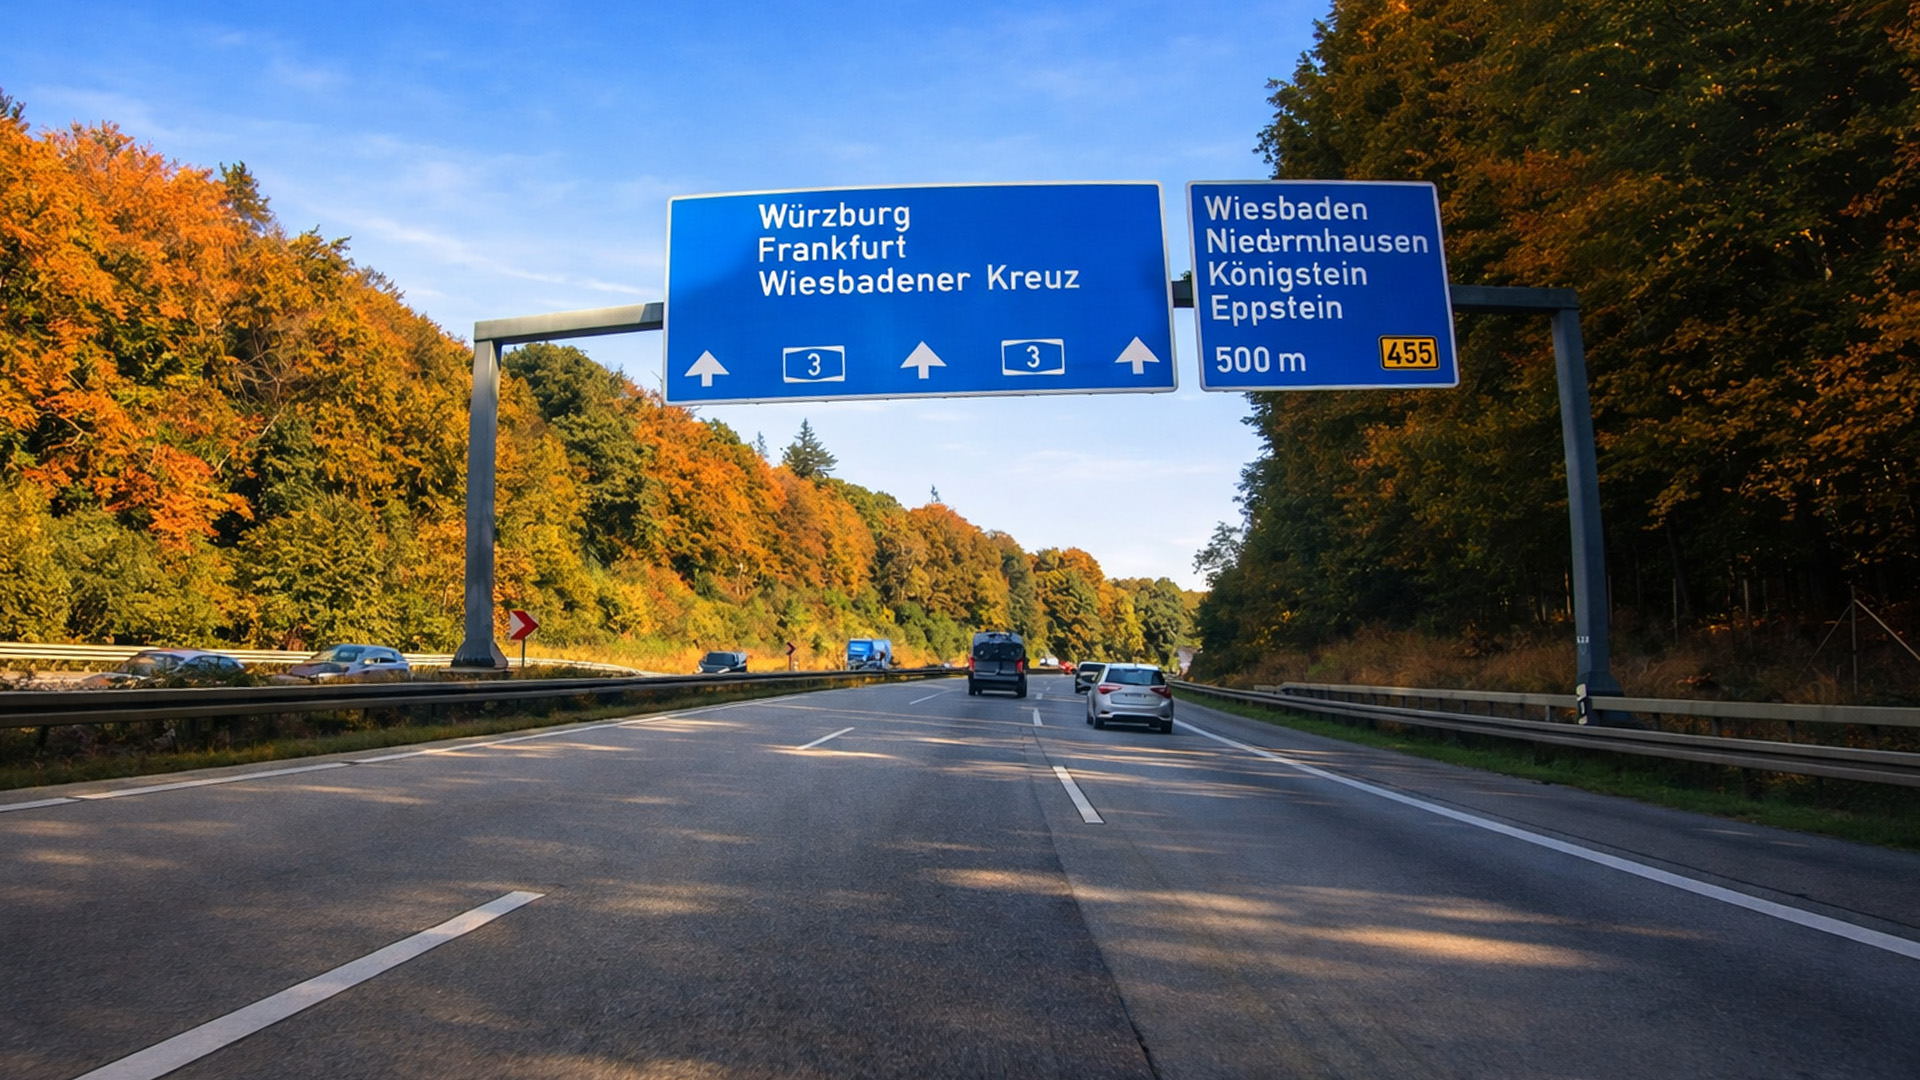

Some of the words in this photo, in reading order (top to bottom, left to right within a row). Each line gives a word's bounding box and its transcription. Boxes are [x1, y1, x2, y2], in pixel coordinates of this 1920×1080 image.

[758, 203, 911, 232] Würzburg
[1204, 195, 1368, 221] Wiesbaden
[758, 235, 906, 262] Frankfurt
[759, 268, 971, 296] Wiesbadener
[987, 264, 1080, 290] Kreuz
[1208, 260, 1367, 292] Königstein
[1211, 294, 1343, 326] Eppstein
[807, 353, 821, 376] 3
[1027, 345, 1040, 368] 3
[1216, 346, 1270, 373] 500
[1279, 351, 1306, 372] m
[1387, 341, 1433, 364] 455
